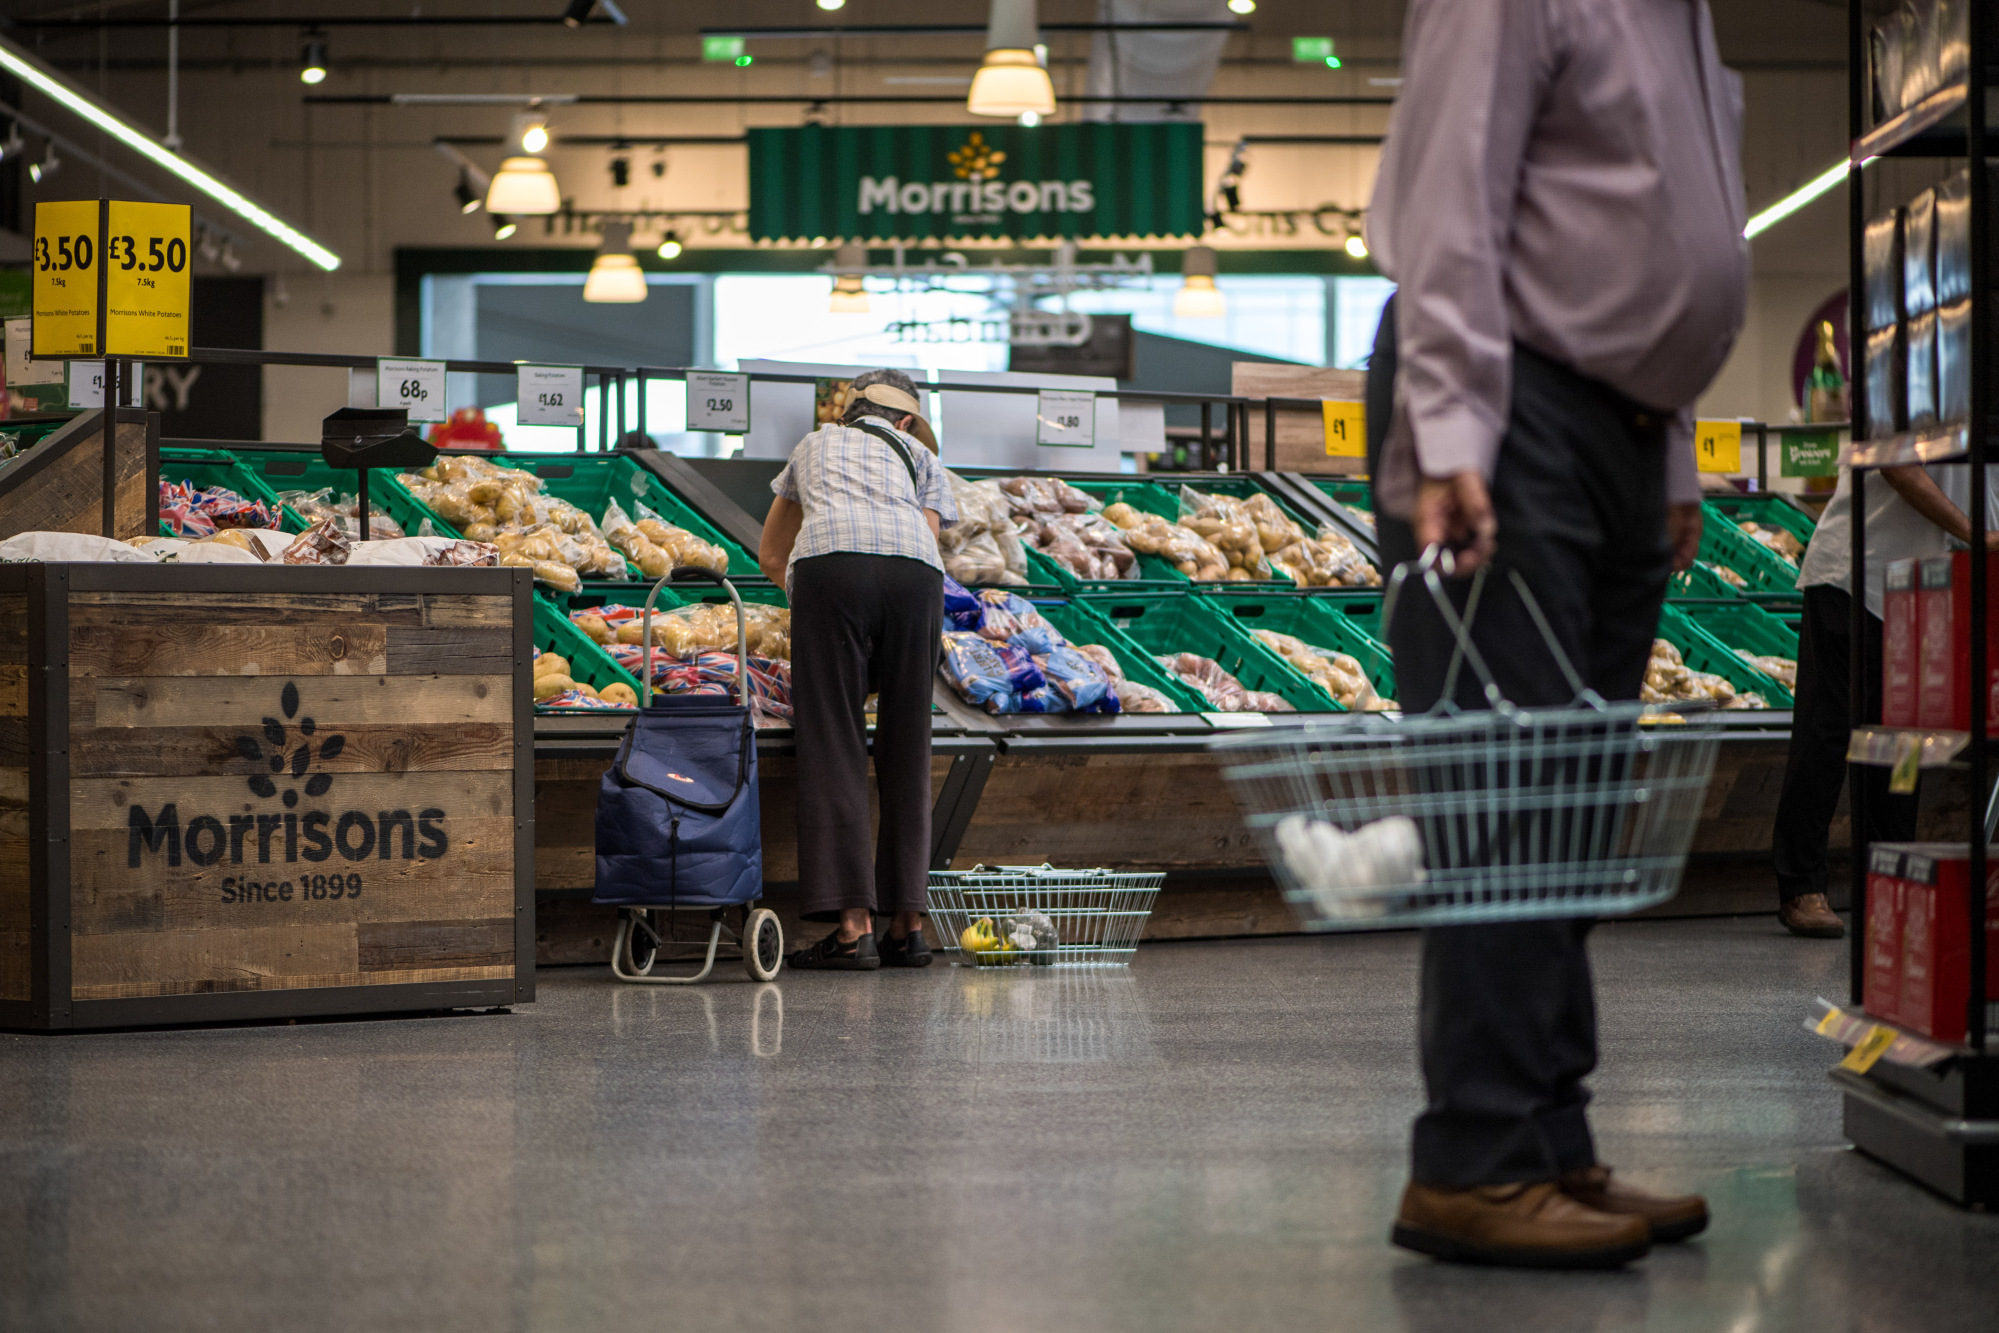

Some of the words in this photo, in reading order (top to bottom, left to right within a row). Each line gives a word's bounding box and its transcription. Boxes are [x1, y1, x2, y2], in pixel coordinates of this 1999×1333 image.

[857, 172, 1095, 215] Morrisons
[35, 235, 93, 271] £3.50
[109, 235, 187, 273] £3.50
[51, 278, 66, 288] 7.5kg
[137, 278, 156, 289] 7.5kg
[109, 308, 138, 317] Morrisons
[138, 309, 156, 318] White
[156, 310, 182, 318] Potatoes
[143, 366, 201, 411] RY
[400, 379, 428, 402] 68p
[539, 393, 564, 406] £1.62
[707, 398, 733, 412] £2.50
[1333, 418, 1345, 440] £1
[1703, 436, 1714, 458] £1
[127, 802, 448, 868] Morrisons
[221, 876, 294, 904] Since
[300, 873, 363, 902] 1899
